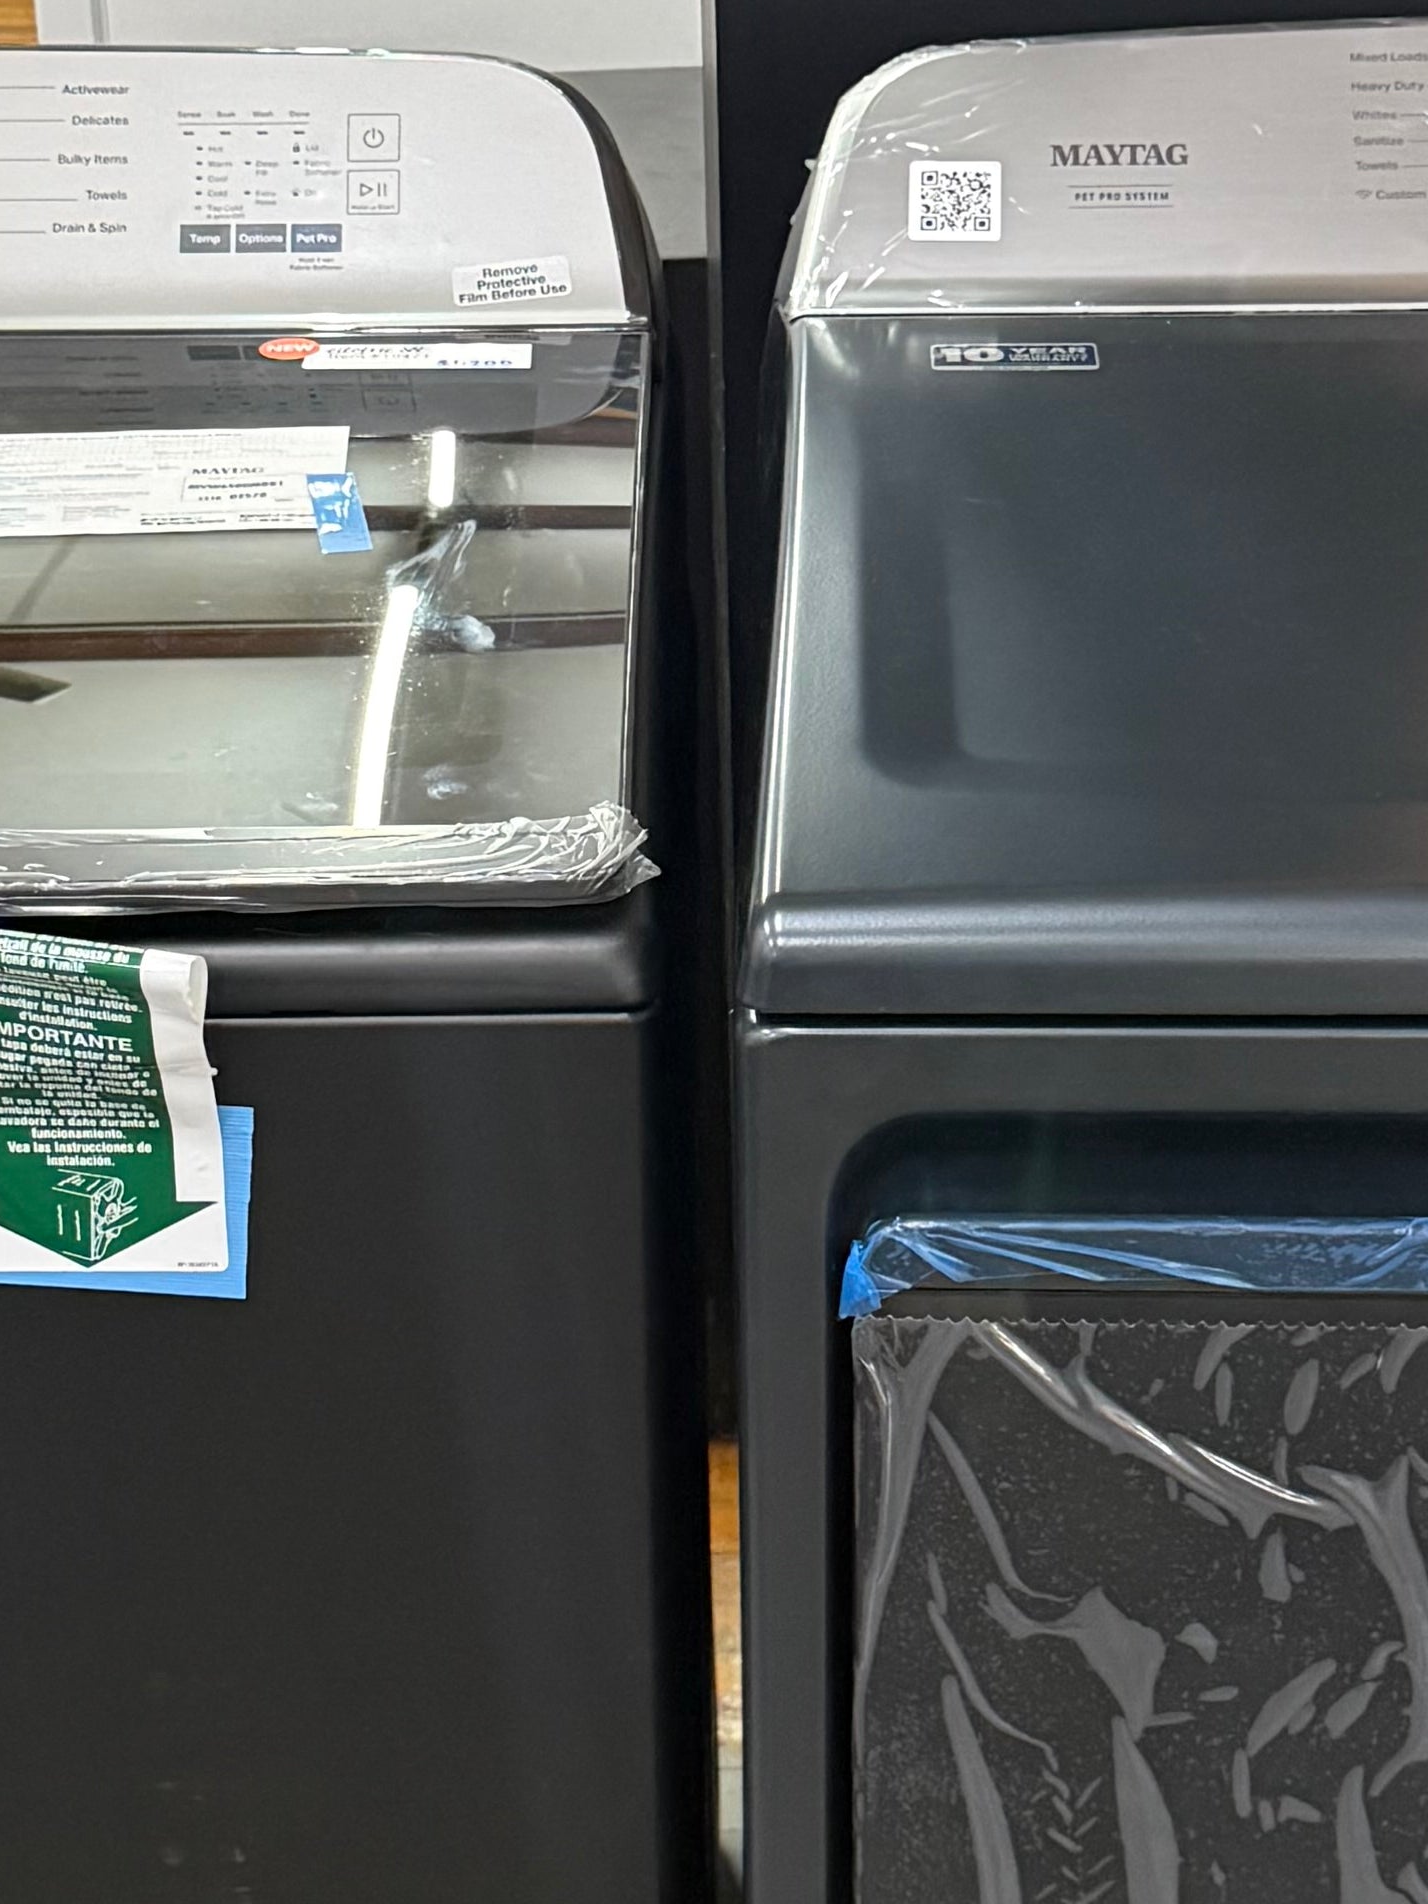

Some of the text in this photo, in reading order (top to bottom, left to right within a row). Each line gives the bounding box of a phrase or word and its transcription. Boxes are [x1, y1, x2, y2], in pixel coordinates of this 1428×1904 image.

[1350, 52, 1428, 62] Mixed Loads
[61, 84, 130, 95] Activewear
[1351, 81, 1425, 92] Heavy Duty
[71, 115, 129, 126] Delicates
[1352, 110, 1397, 120] Whites
[1353, 136, 1404, 146] Sanitize
[57, 153, 128, 166] Bulky Items
[1050, 143, 1190, 167] MAYTAG
[1356, 161, 1399, 171] Towels
[85, 190, 128, 201] Towels
[1074, 192, 1170, 201] PET PRO SYSTEM
[1375, 190, 1427, 200] Custom
[52, 222, 128, 236] Drain & Spin
[190, 233, 221, 245] Temp
[239, 233, 284, 246] Options
[296, 233, 337, 244] Pet Pro
[482, 264, 538, 278] Remove
[477, 276, 546, 290] Protective
[459, 284, 567, 303] Film Before Use
[266, 344, 316, 354] NEW
[935, 347, 1086, 362] 10 YEAR
[74, 1051, 105, 1061] estar
[107, 1054, 123, 1062] en
[126, 1055, 140, 1063] su
[31, 1128, 127, 1139] funcionamiento.
[7, 1141, 152, 1153] Vea las de
